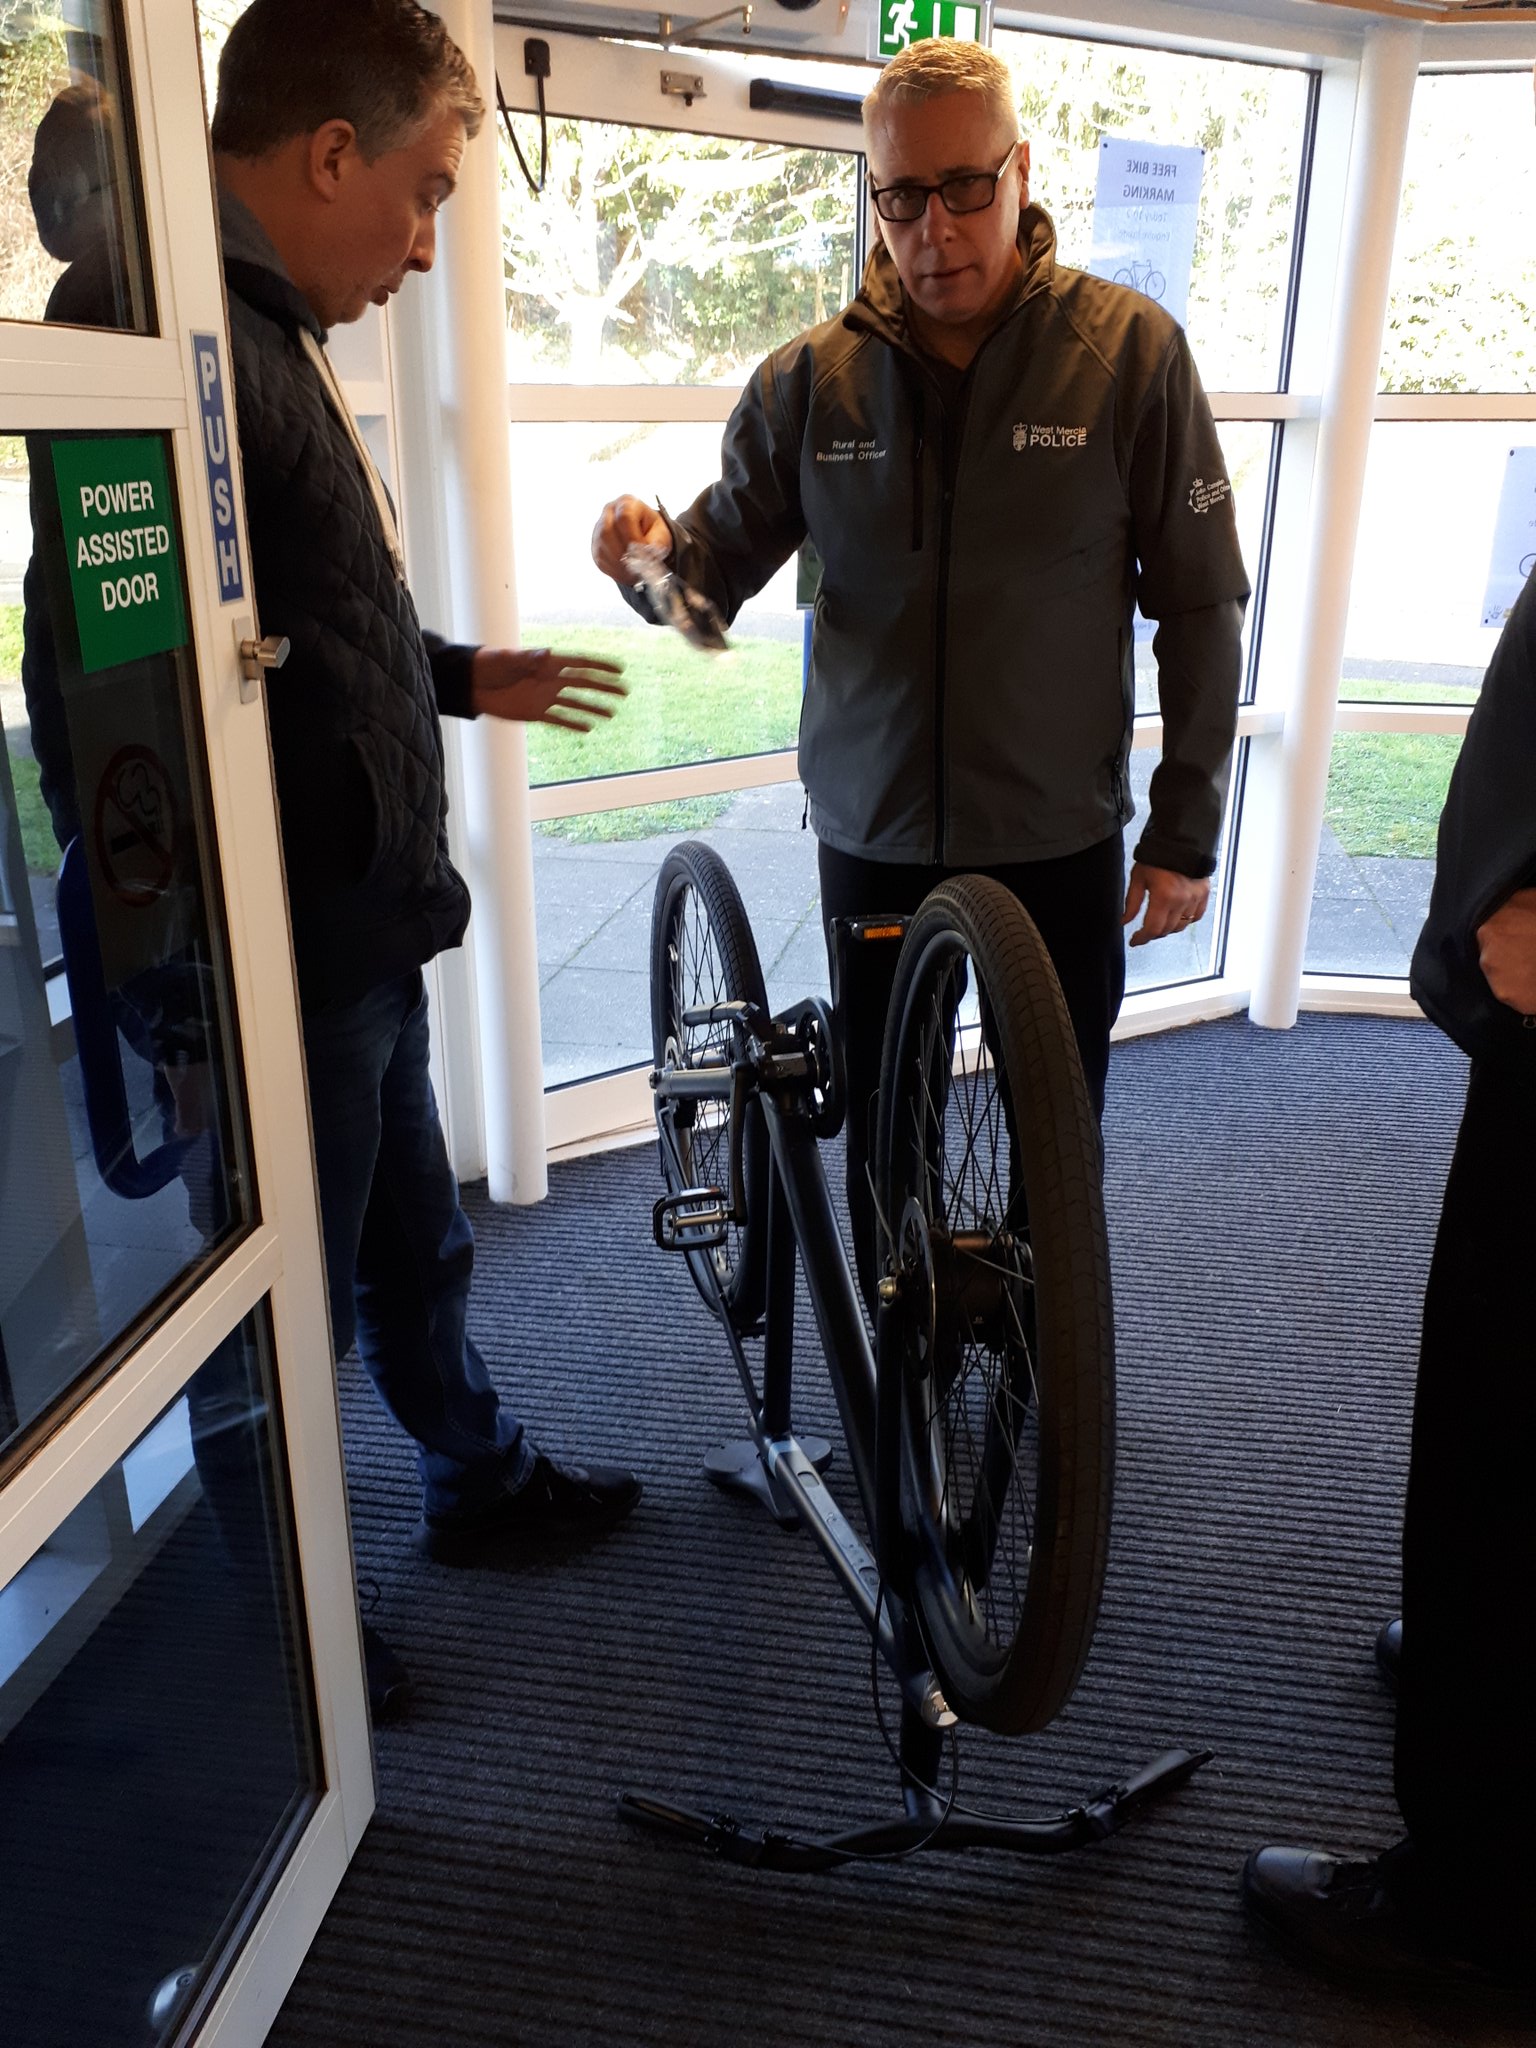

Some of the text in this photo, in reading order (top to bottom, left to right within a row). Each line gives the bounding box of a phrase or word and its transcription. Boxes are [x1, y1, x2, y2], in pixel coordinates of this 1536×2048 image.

[1029, 434, 1088, 447] POLICE
[1030, 424, 1087, 435] West Mercia
[816, 449, 887, 463] Business Officer
[831, 439, 876, 450] Rural and
[198, 350, 240, 587] PUSH
[79, 479, 155, 518] POWER
[76, 524, 170, 569] ASSISTED
[101, 571, 160, 613] DOOR
